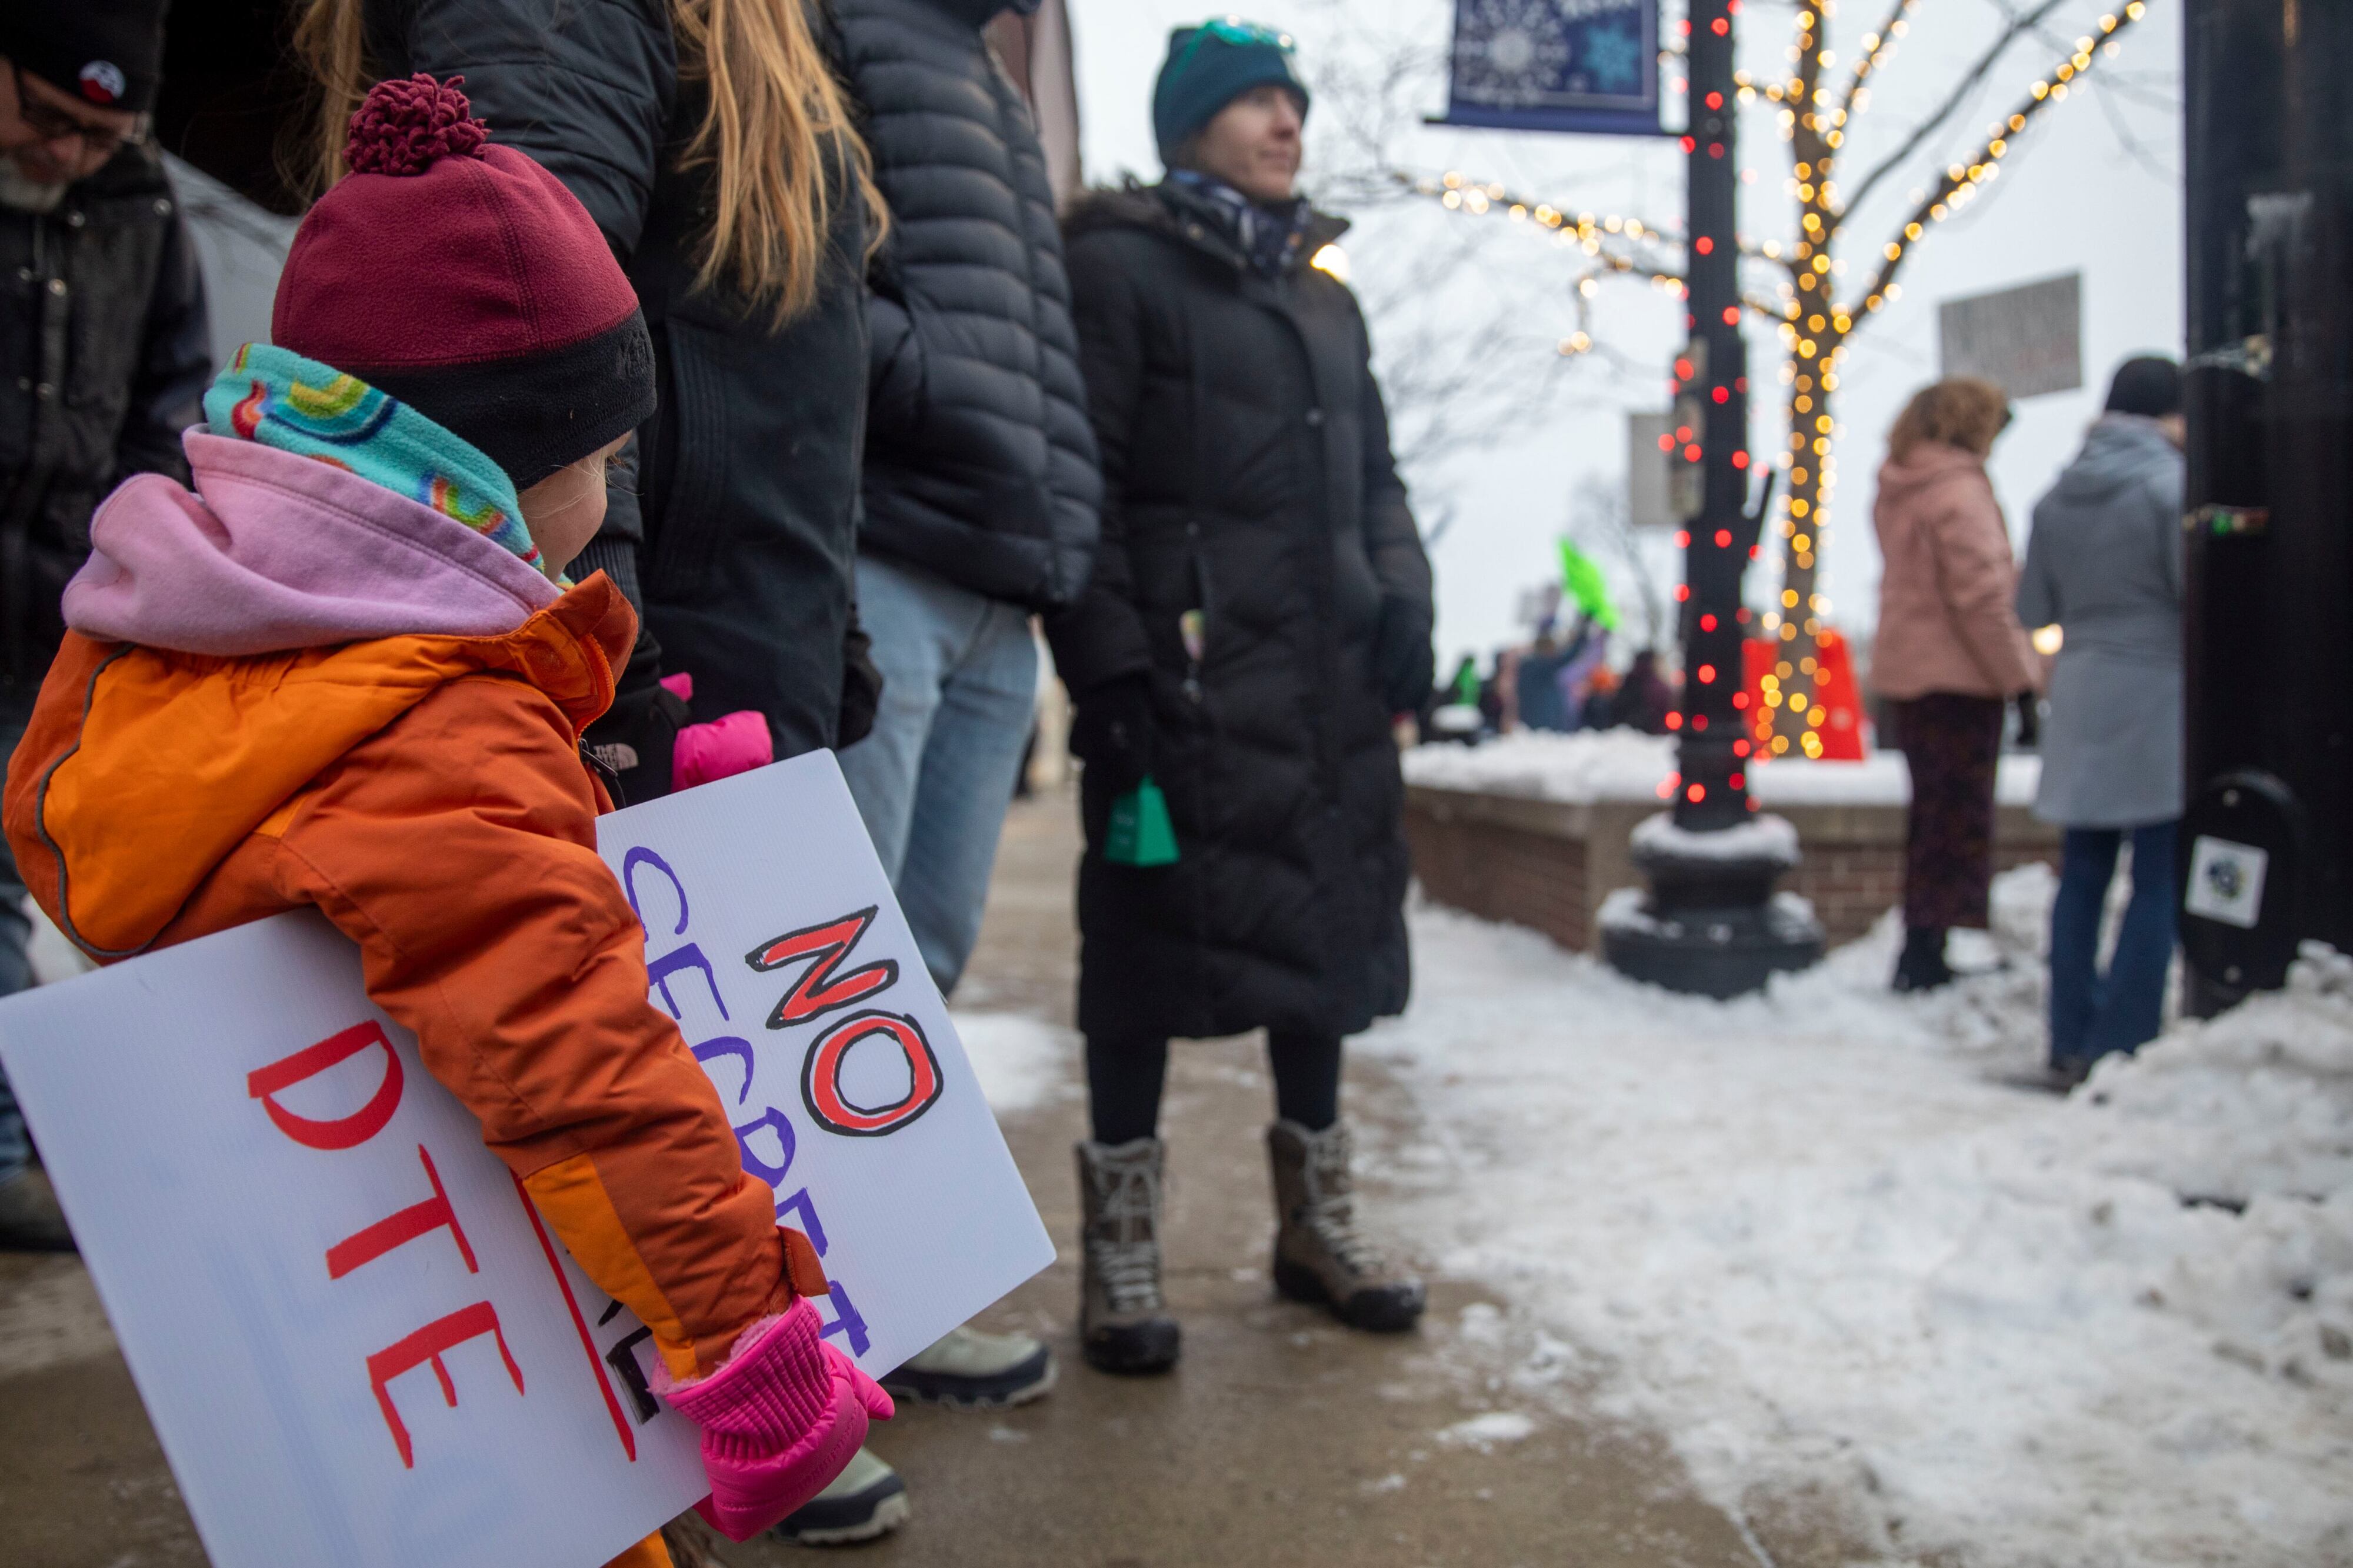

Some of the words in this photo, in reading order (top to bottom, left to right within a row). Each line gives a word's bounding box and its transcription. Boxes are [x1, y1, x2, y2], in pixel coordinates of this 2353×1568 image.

[593, 744, 615, 756] THE
[745, 905, 943, 1136] NO
[247, 1020, 525, 1469] DTE
